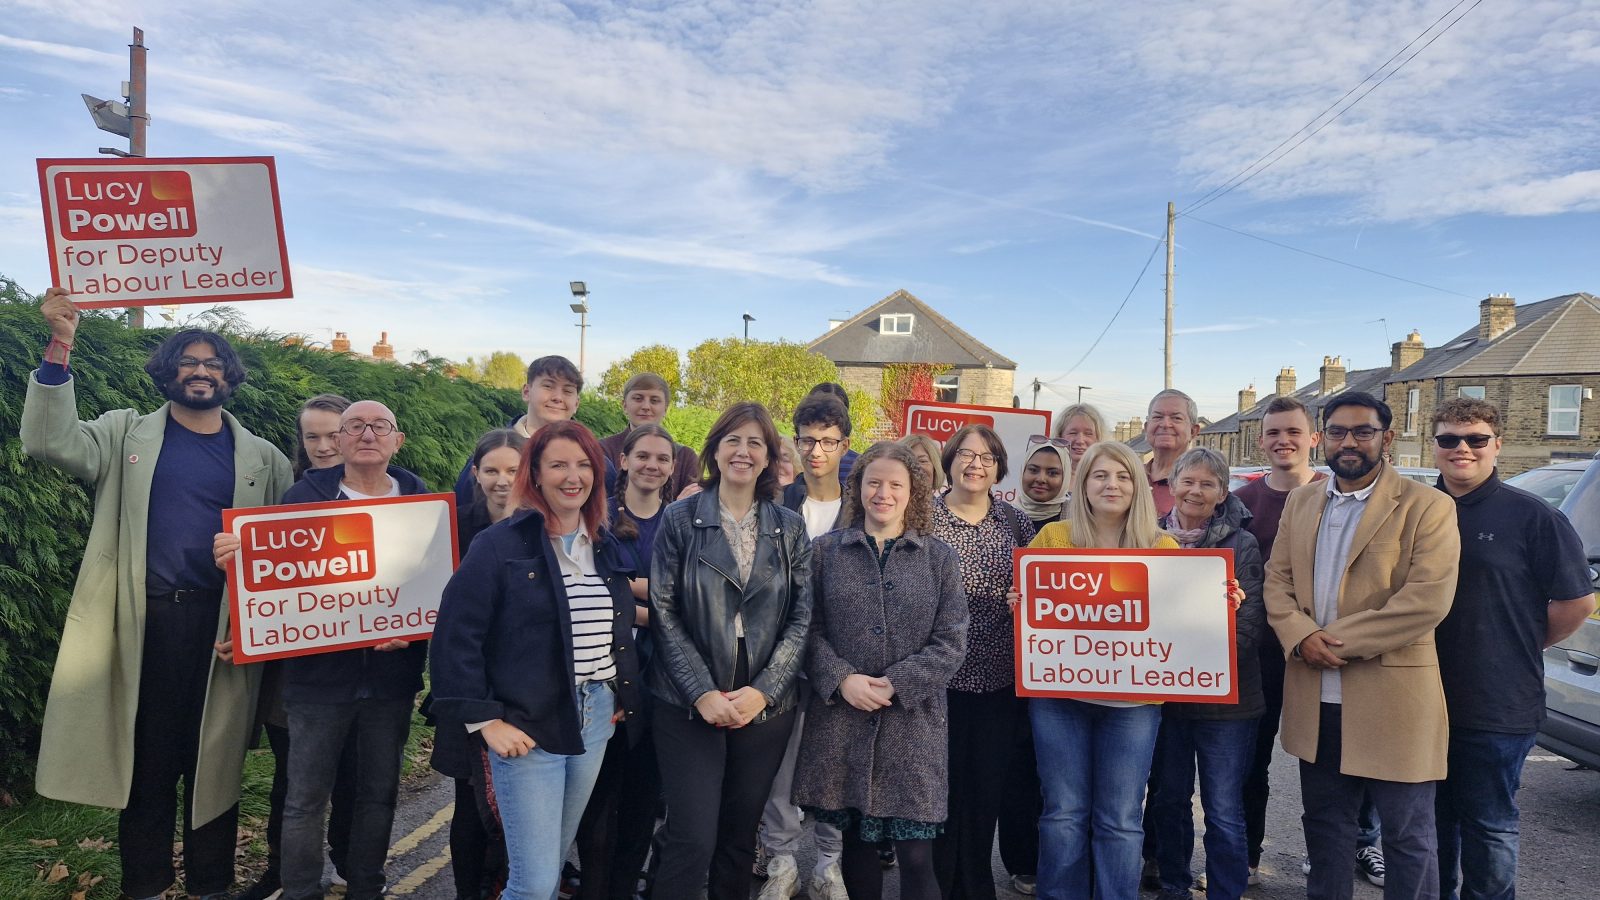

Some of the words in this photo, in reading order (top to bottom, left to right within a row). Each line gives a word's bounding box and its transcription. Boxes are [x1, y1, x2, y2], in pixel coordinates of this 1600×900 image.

[65, 177, 143, 205] Lucy
[68, 207, 190, 233] Powell
[63, 246, 108, 267] for
[117, 243, 223, 267] Deputy
[68, 273, 173, 295] Labour
[182, 267, 278, 290] Leader
[916, 413, 964, 433] Lucy
[250, 527, 327, 552] Lucy
[252, 549, 369, 584] Powell
[1035, 566, 1103, 596] Lucy
[245, 598, 289, 619] for
[297, 585, 400, 613] Deputy
[1035, 598, 1142, 623] Powell
[249, 620, 350, 647] Labour
[359, 607, 438, 634] Leade
[1027, 634, 1066, 655] for
[1074, 635, 1173, 663] Deputy
[1029, 662, 1123, 685] Labour
[1131, 665, 1225, 688] Leader
